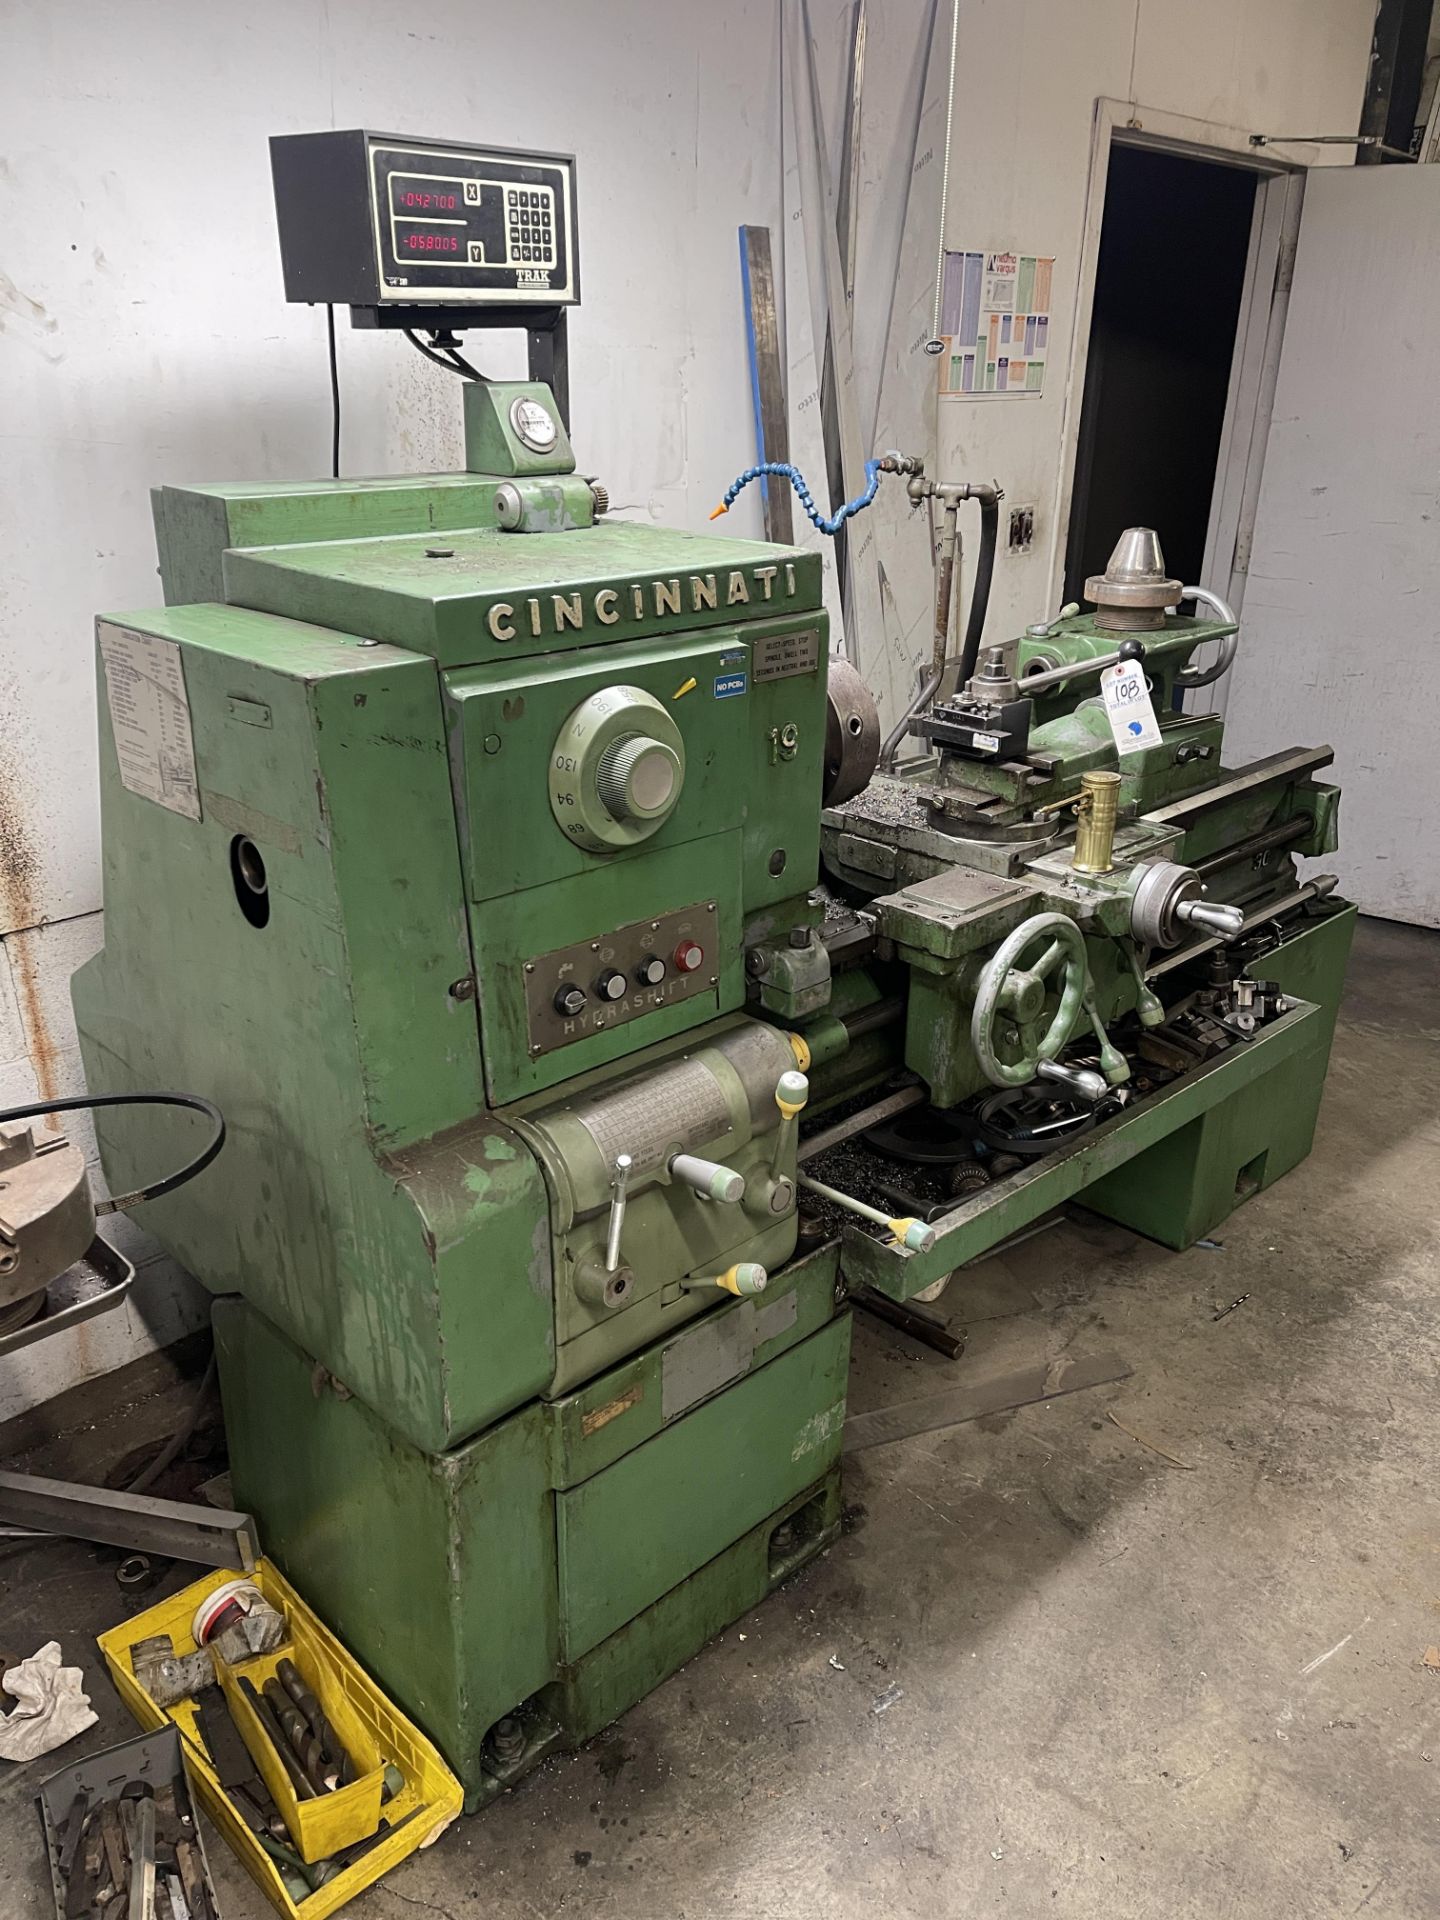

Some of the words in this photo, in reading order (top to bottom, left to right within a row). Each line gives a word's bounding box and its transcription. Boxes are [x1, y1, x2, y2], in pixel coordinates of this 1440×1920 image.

[468, 186, 476, 199] X
[472, 247, 479, 260] Y
[516, 269, 551, 282] TRAK
[488, 563, 796, 642] CINCINNATI
[716, 683, 727, 691] NO
[1115, 680, 1140, 703] 108
[591, 697, 614, 716] 190
[555, 755, 577, 772] 130
[557, 793, 575, 806] 94
[567, 823, 585, 834] 68
[563, 976, 690, 1035] HYDRASHIFT
